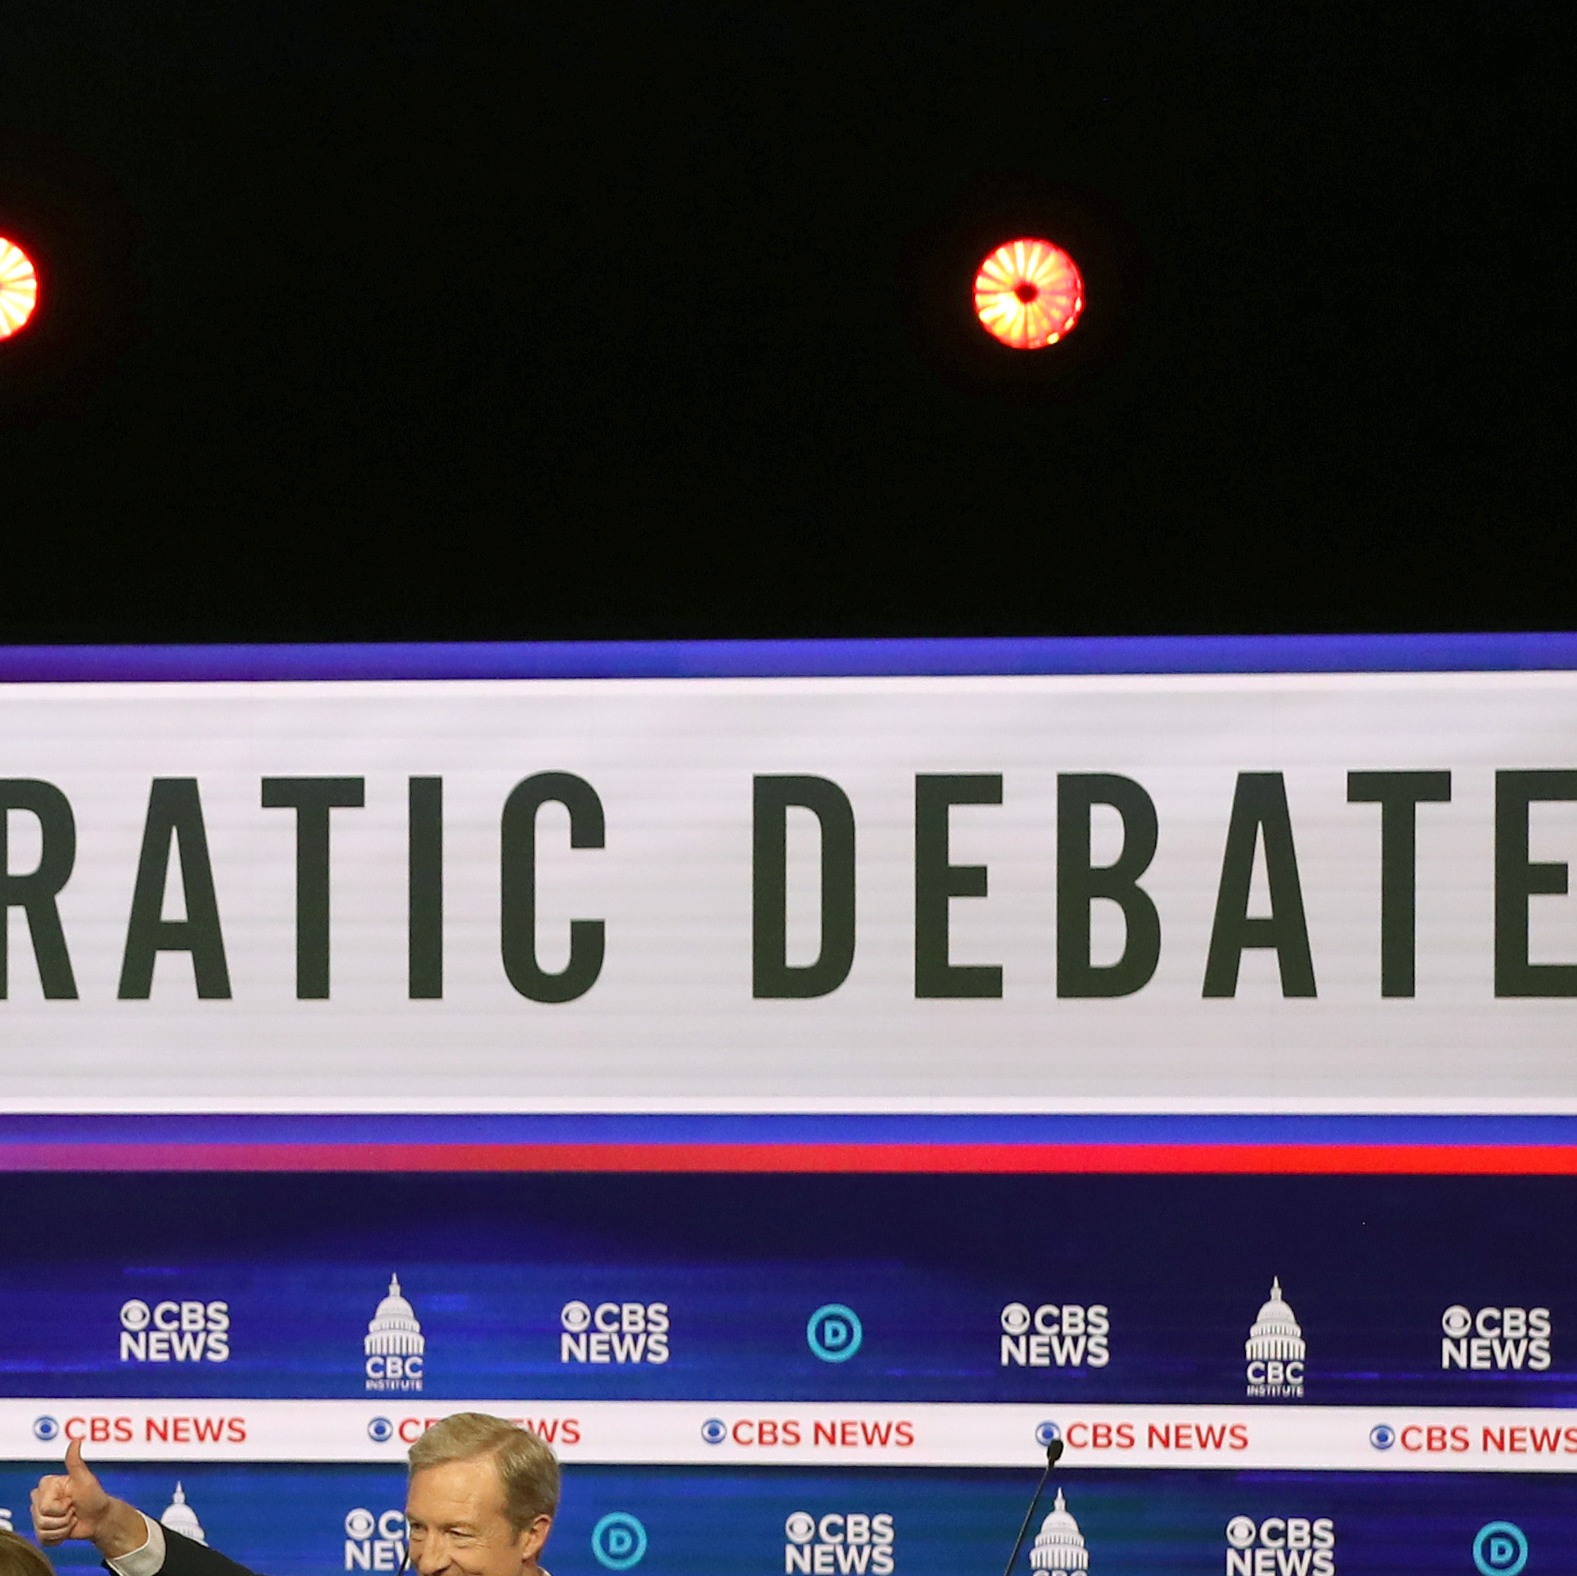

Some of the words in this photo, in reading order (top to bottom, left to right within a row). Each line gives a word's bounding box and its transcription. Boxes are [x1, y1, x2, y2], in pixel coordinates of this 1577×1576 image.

[753, 770, 1577, 998] DEBATE
[153, 1301, 229, 1331] CBS
[595, 1303, 670, 1333] CBS
[1033, 1305, 1109, 1334] CBS
[1476, 1308, 1551, 1337] CBS
[121, 1332, 229, 1362] NEWS
[824, 1320, 848, 1347] D
[561, 1334, 670, 1364] NEWS
[1001, 1335, 1109, 1366] NEWS
[1442, 1338, 1551, 1369] NEWS
[366, 1356, 423, 1379] CBC
[1247, 1363, 1304, 1385] CBC
[1248, 1386, 1304, 1397] INSTITUTE
[64, 1417, 133, 1442] CBS
[146, 1417, 246, 1443] NEWS
[512, 1418, 581, 1444] WS
[733, 1420, 801, 1446] CBS
[815, 1421, 914, 1447] NEWS
[1067, 1423, 1135, 1449] CBS
[1149, 1424, 1248, 1450] NEWS
[1401, 1426, 1470, 1452] CBS
[1483, 1427, 1577, 1453] NEWS
[609, 1529, 633, 1554] D
[818, 1513, 894, 1543] CBS
[1260, 1517, 1335, 1547] CBS
[785, 1544, 894, 1575] NEWS
[1490, 1537, 1514, 1564] D
